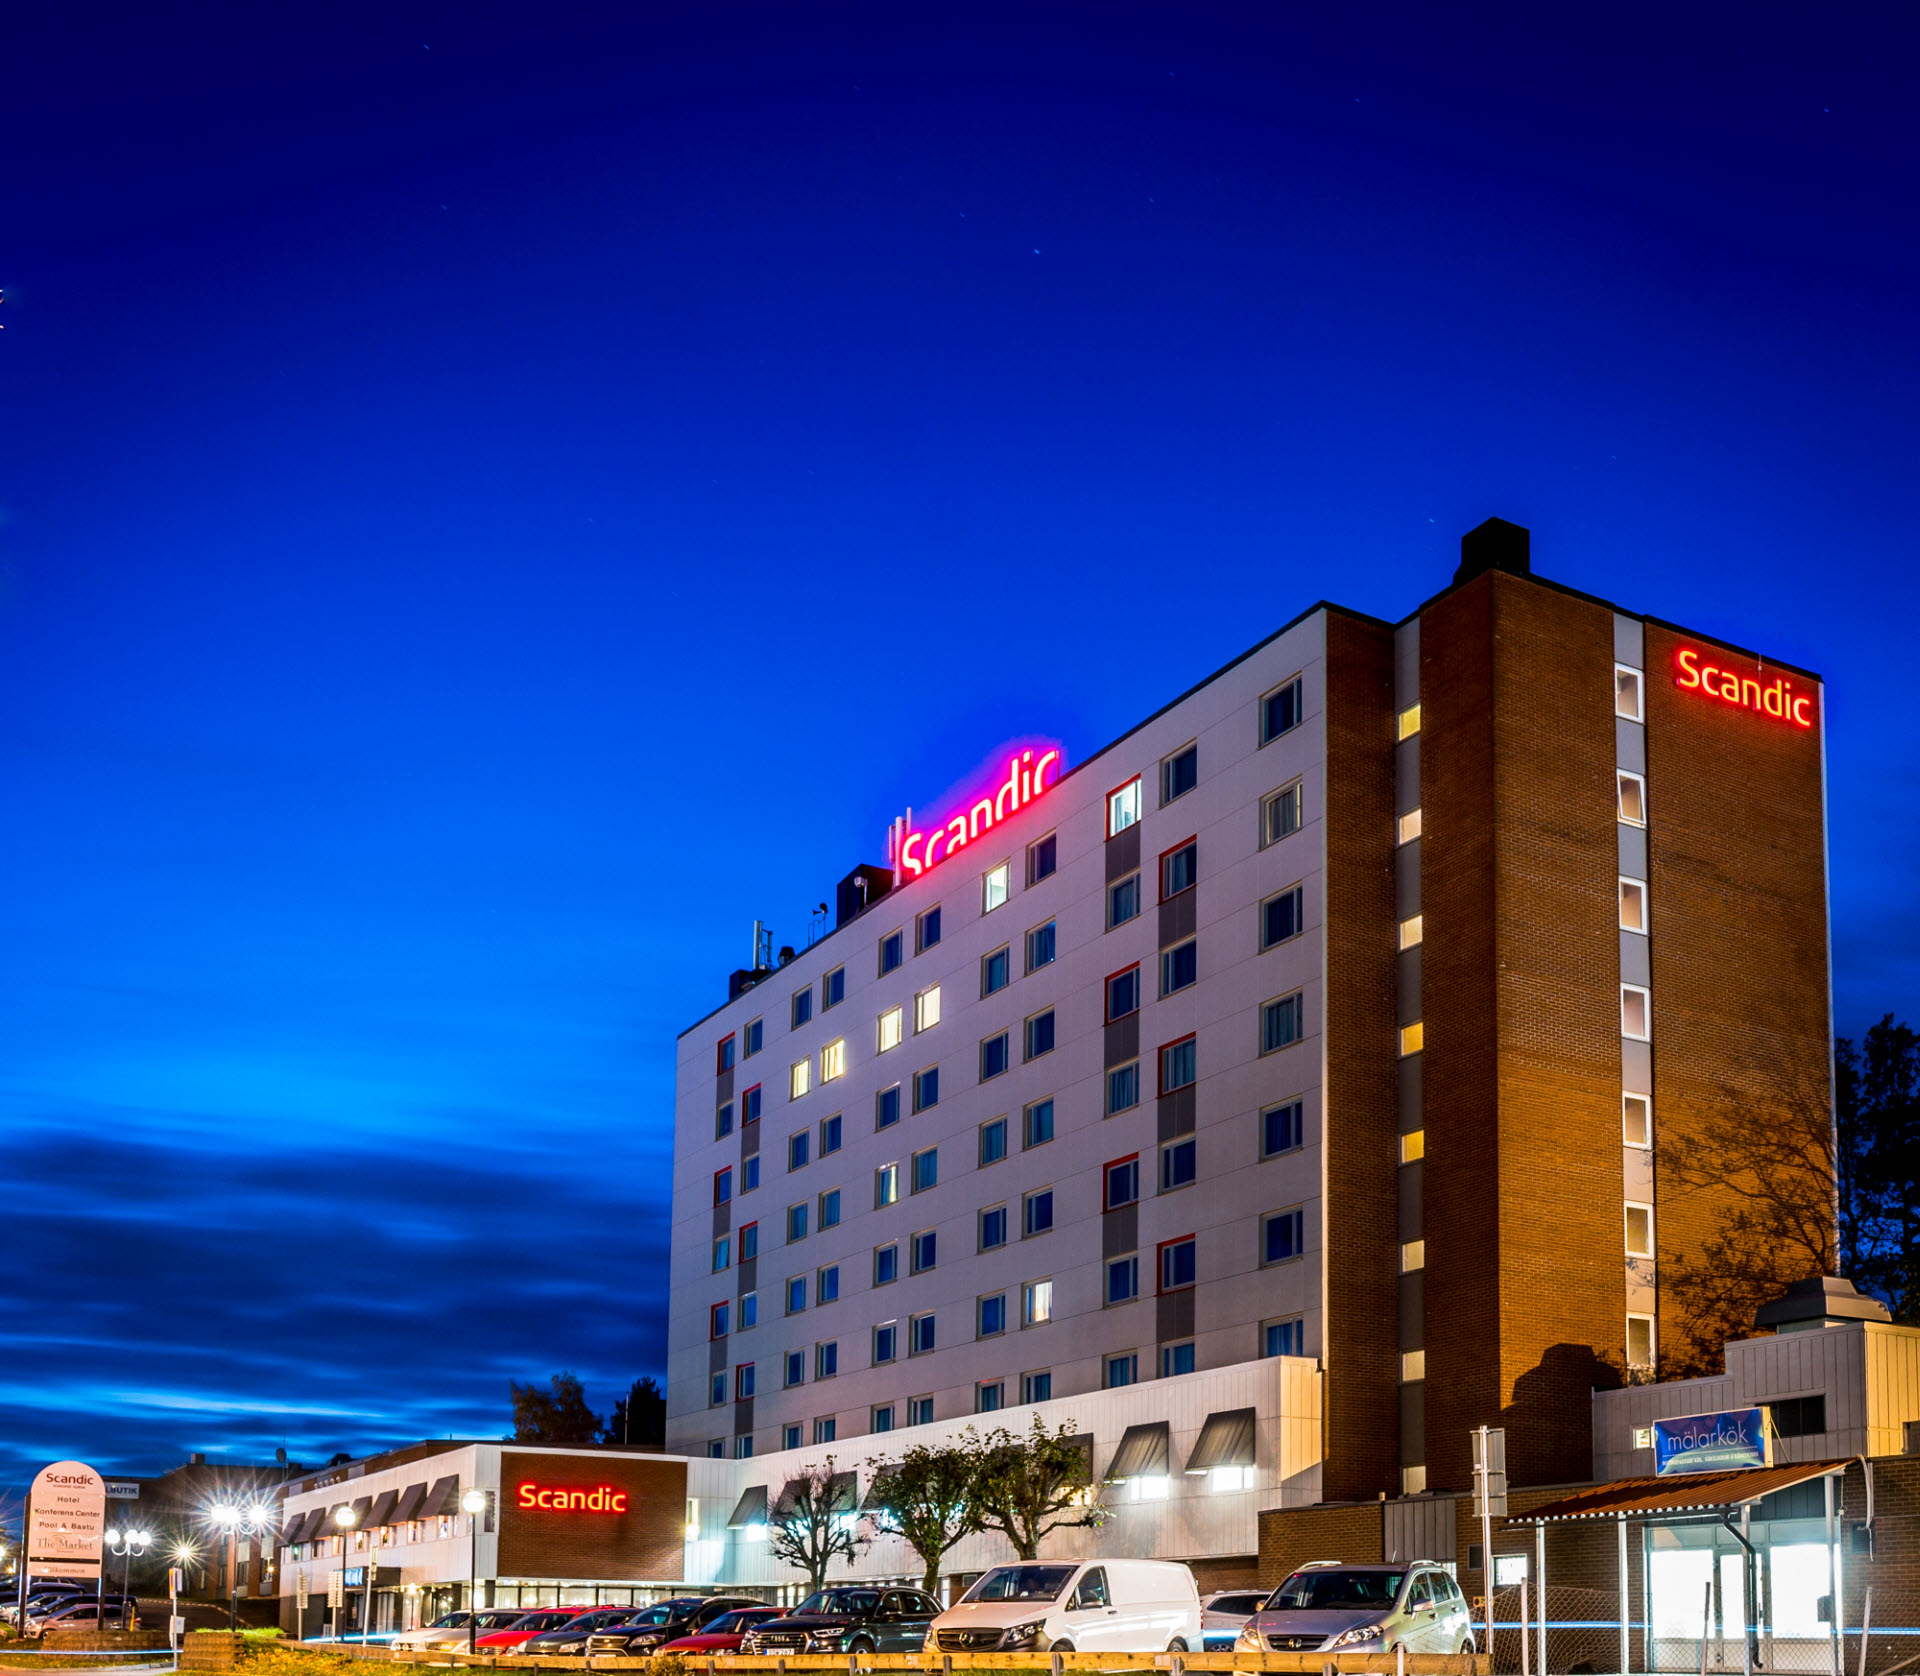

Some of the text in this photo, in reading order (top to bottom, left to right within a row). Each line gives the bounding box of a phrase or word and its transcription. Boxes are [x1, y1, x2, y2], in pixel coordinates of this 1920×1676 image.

[1676, 650, 1811, 727] Scandic
[901, 750, 1057, 876] Scandic
[1667, 1420, 1749, 1451] mälarkök
[46, 1472, 94, 1485] Scandic
[518, 1484, 627, 1512] Scandic
[35, 1508, 74, 1516] Konferens
[39, 1521, 58, 1529] Pool
[71, 1523, 95, 1531] Bastu
[37, 1537, 93, 1550] The Market
